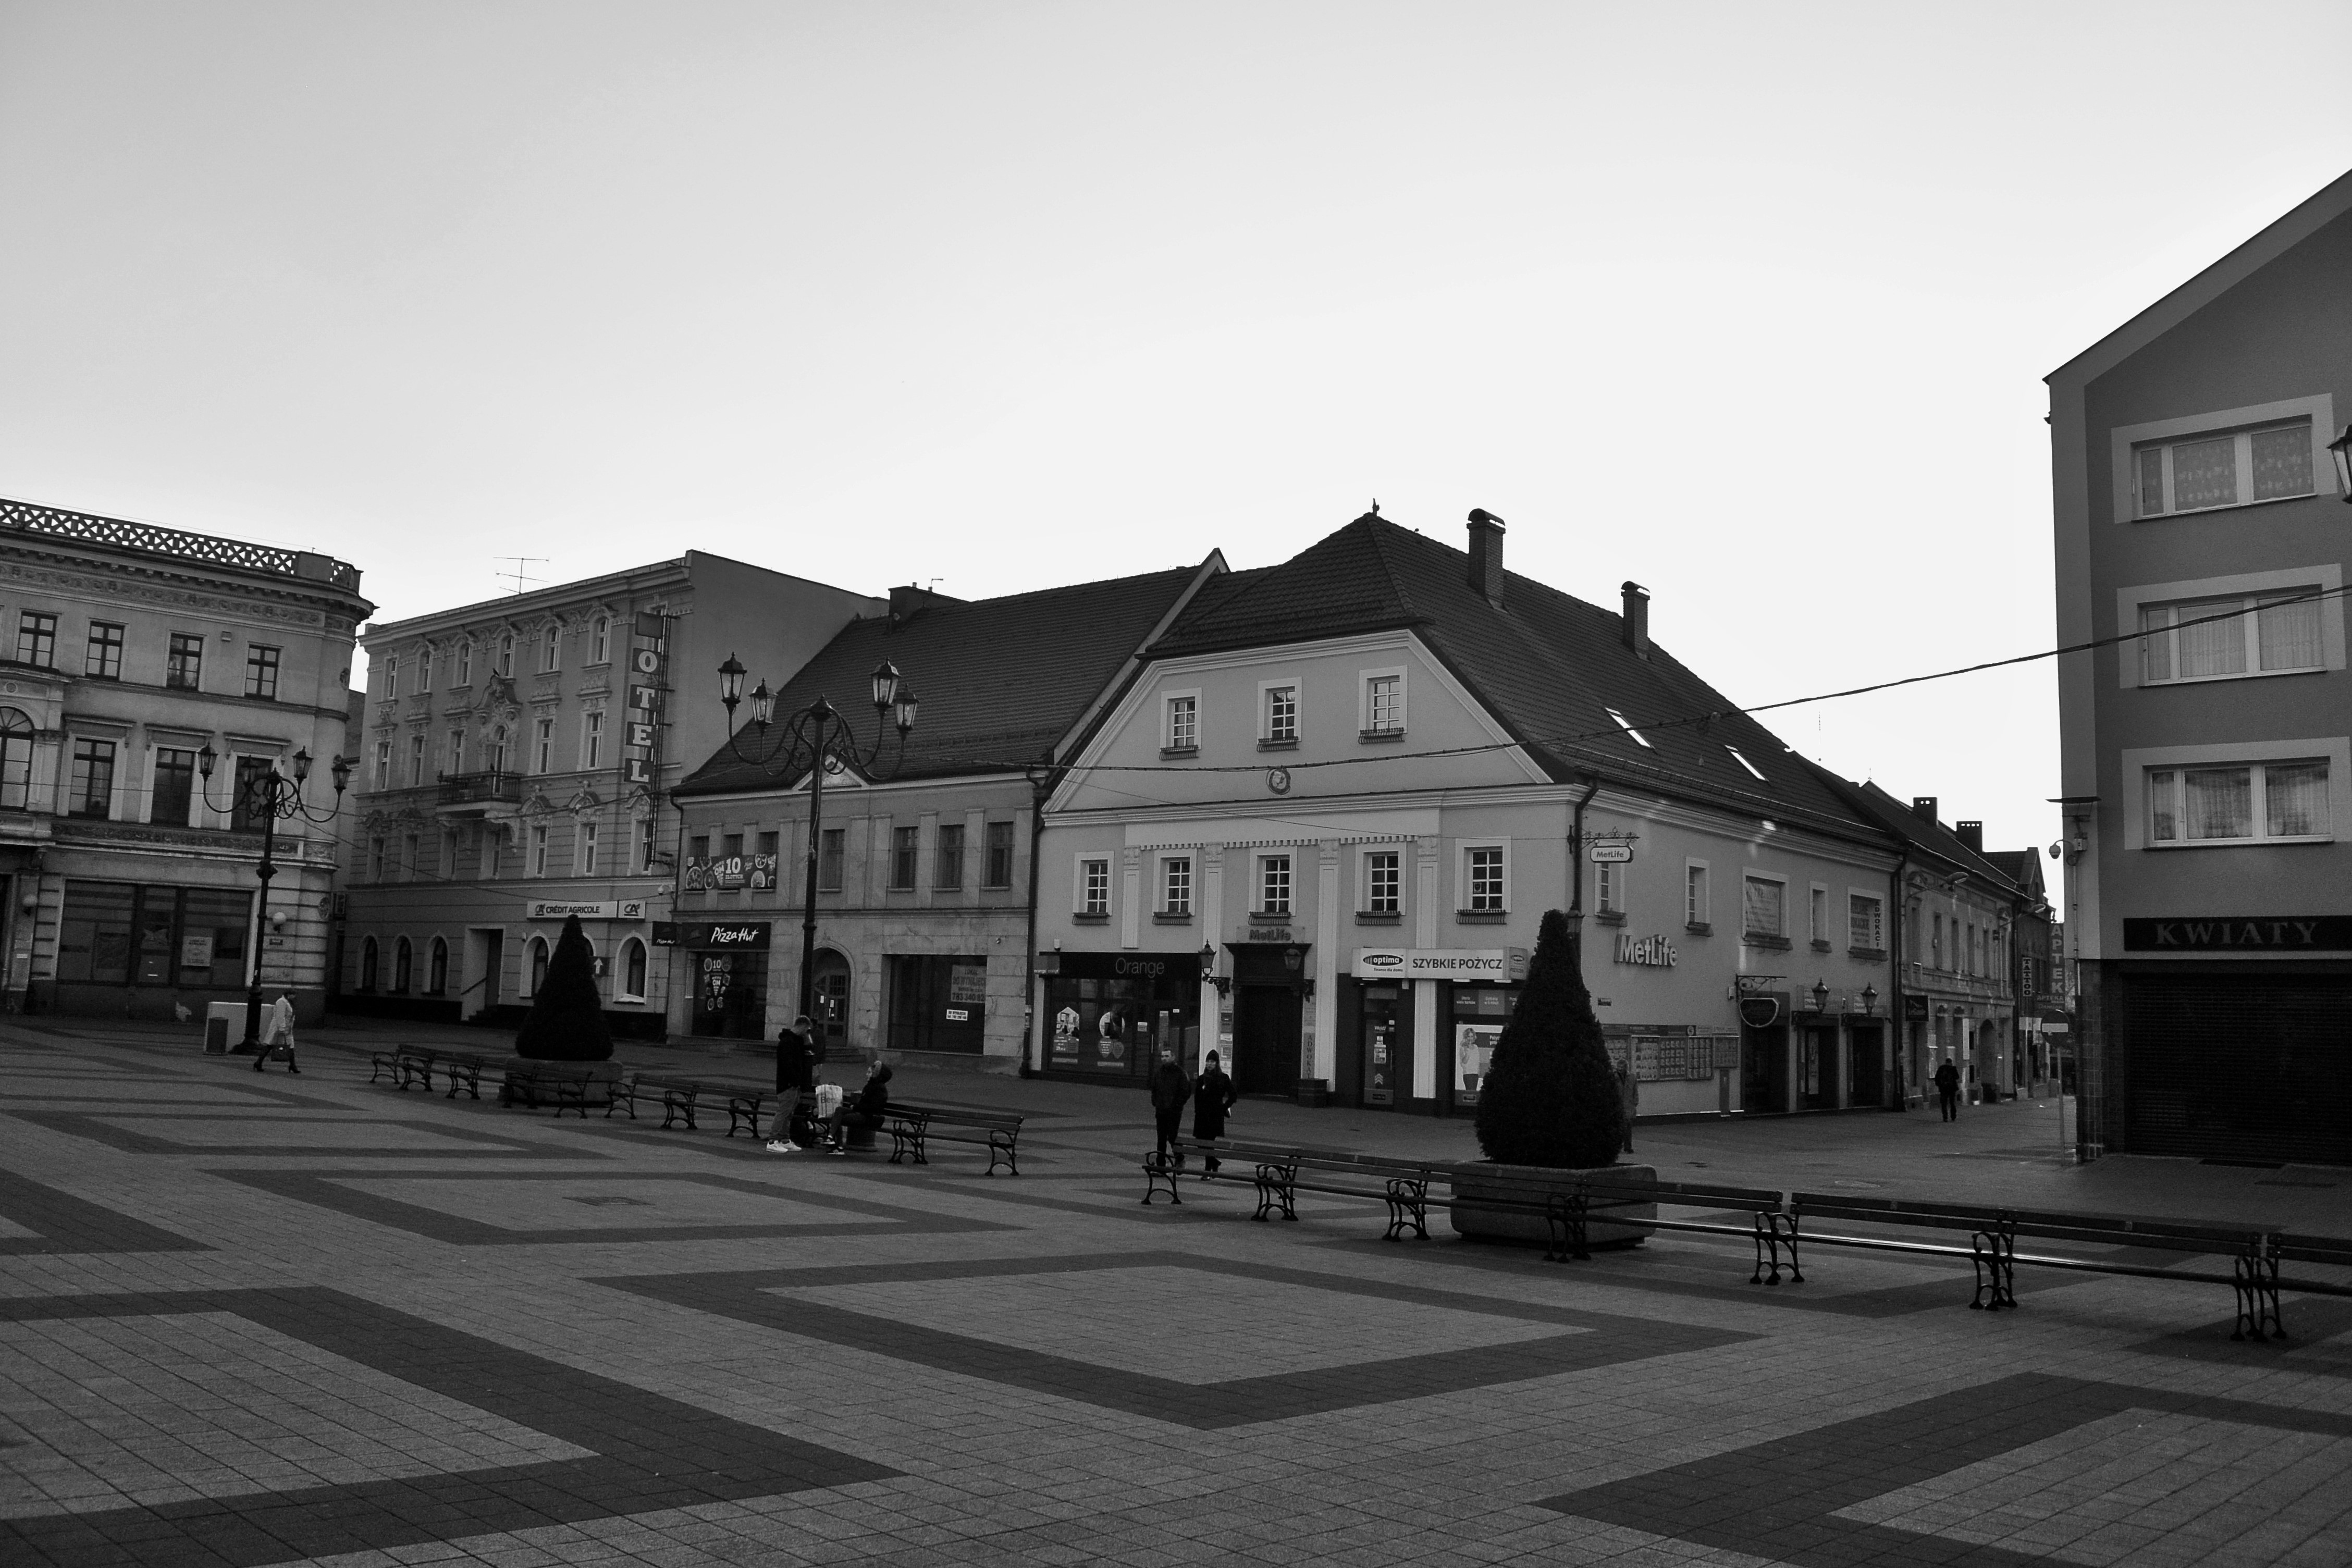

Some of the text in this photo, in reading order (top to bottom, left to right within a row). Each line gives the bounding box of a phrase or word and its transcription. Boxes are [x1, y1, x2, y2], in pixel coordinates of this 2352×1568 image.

[725, 857, 741, 874] 10
[546, 905, 568, 913] CRÉDIT
[710, 927, 759, 943] Pizza Hut
[1249, 928, 1291, 941] MetLife
[2154, 921, 2318, 945] KWIATY
[1614, 934, 1678, 967] MetLife
[713, 959, 721, 969] 10
[1373, 956, 1400, 965] optima
[1413, 958, 1456, 969] SZYBKIE
[1459, 957, 1503, 969] POŻYCZ
[1115, 957, 1164, 979] Orange
